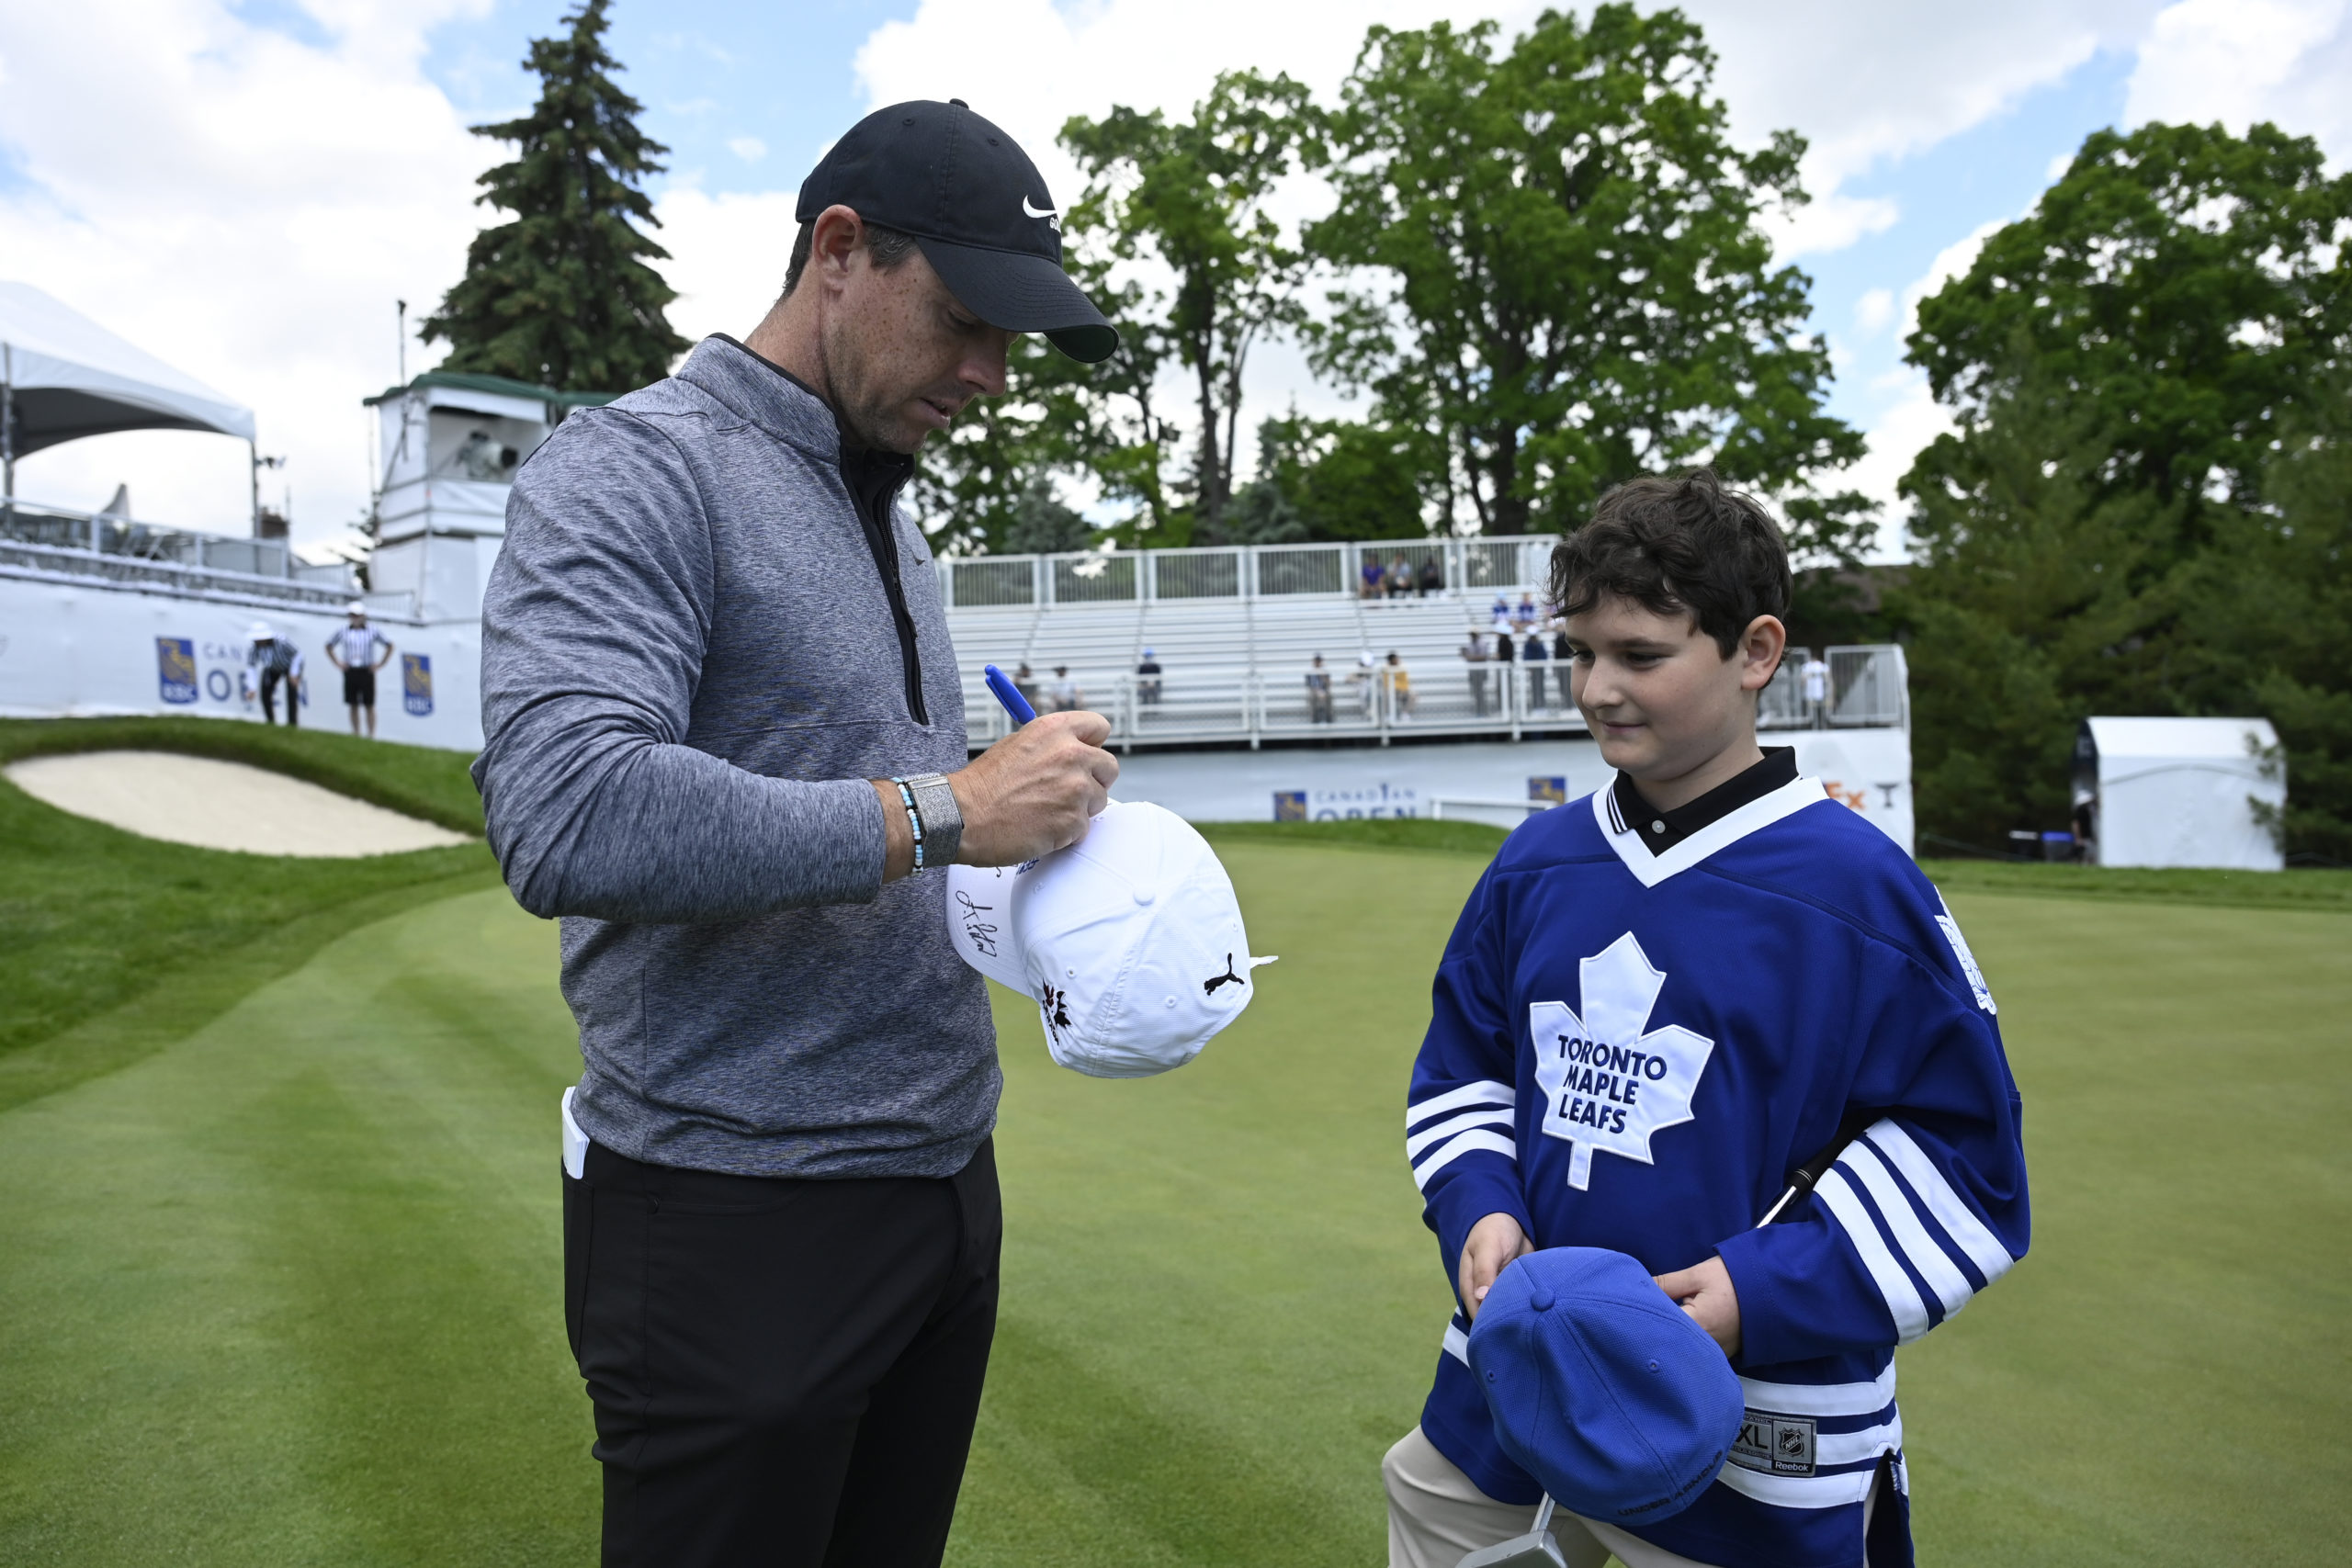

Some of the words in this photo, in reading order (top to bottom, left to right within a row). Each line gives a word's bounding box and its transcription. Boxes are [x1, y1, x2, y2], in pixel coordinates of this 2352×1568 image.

[1557, 1034, 1668, 1081] TORONTO
[1562, 1065, 1639, 1105] MAPLE
[1558, 1093, 1627, 1134] LEAFS
[1785, 1435, 1800, 1450] NHL
[1775, 1461, 1810, 1472] Reebok
